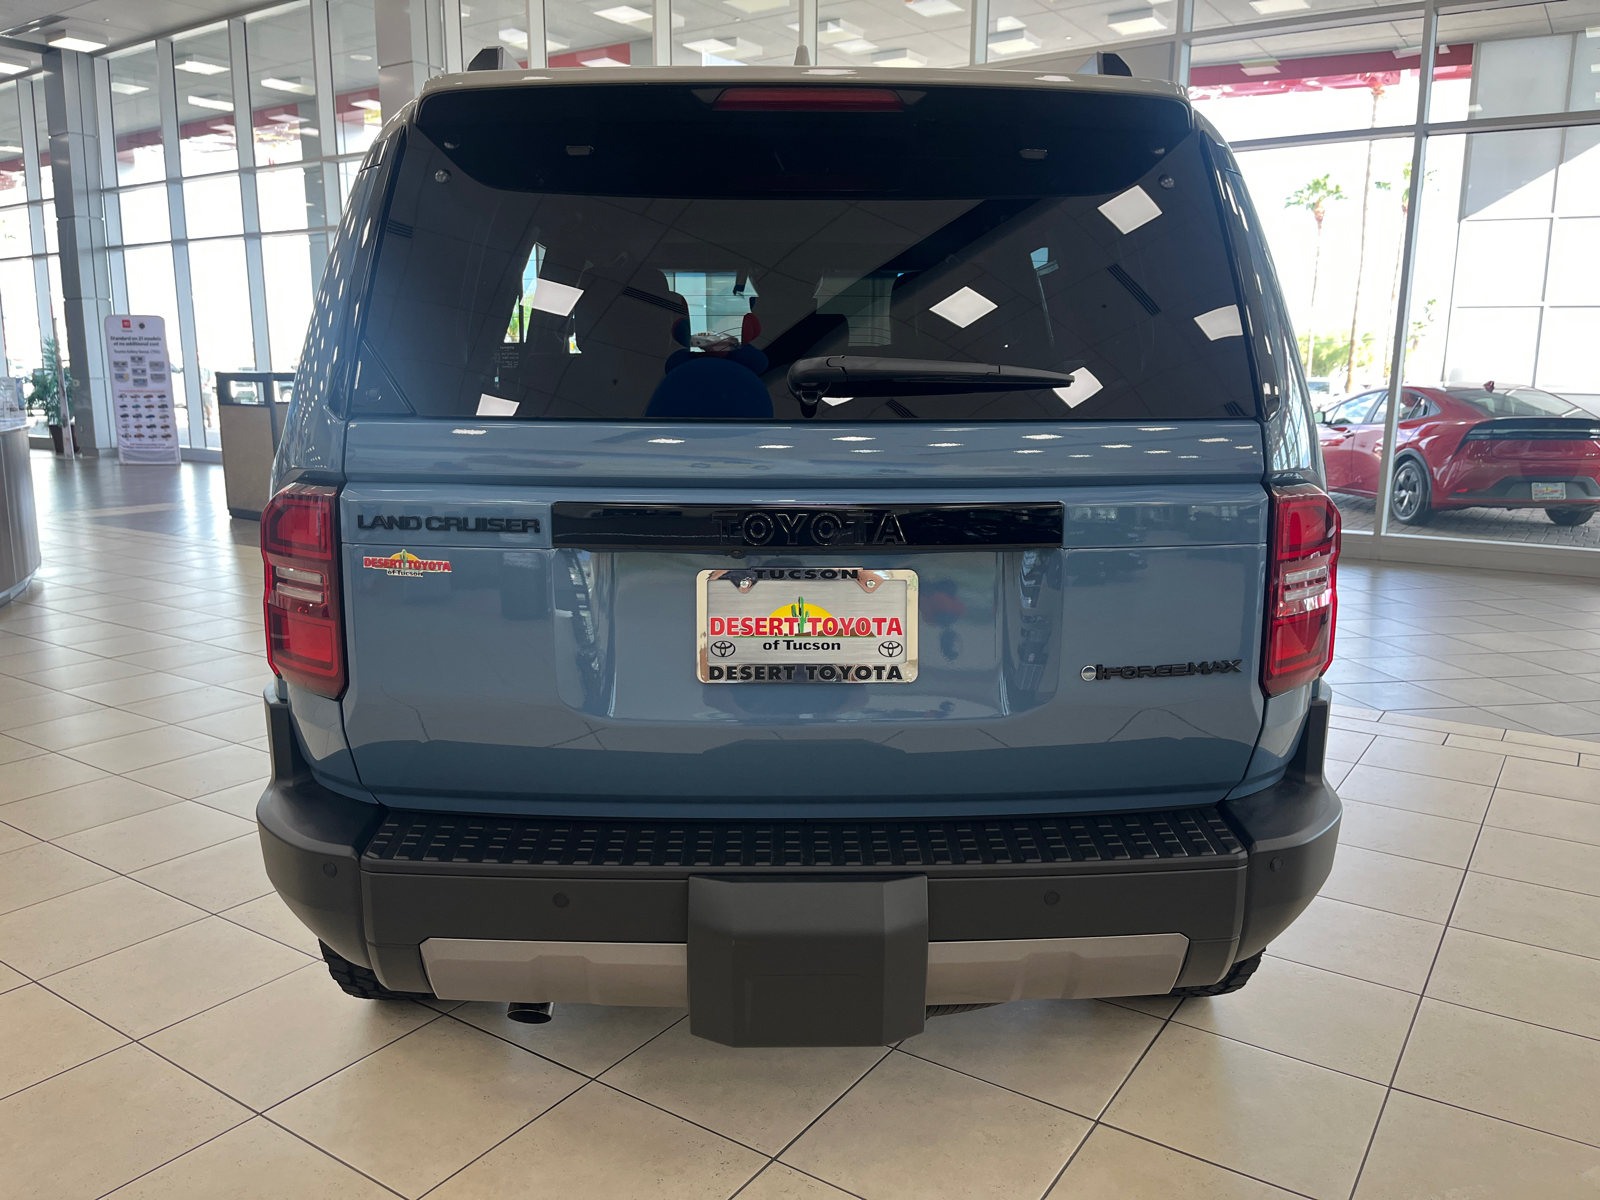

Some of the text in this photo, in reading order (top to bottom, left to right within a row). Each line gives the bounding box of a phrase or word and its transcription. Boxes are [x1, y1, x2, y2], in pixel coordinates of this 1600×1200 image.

[358, 515, 541, 533] LAND CRUISER
[711, 512, 907, 546] TOYOTA
[364, 557, 451, 572] DESERT TOYOTA
[754, 569, 858, 580] TUCSON
[710, 617, 903, 636] DESERT TOYOTA
[762, 640, 841, 651] of Tucson
[709, 665, 904, 681] DESERT TOYOTA
